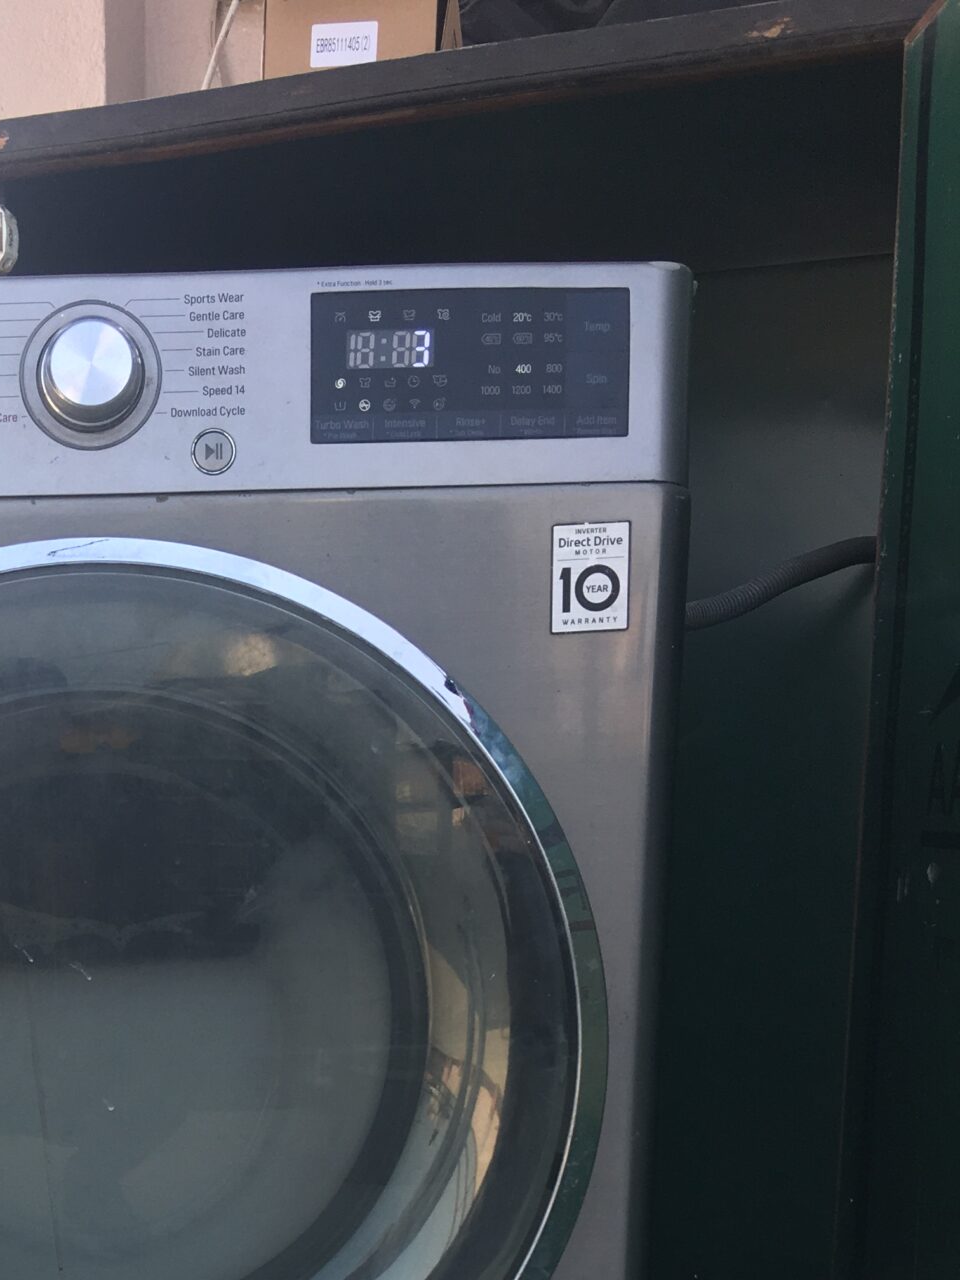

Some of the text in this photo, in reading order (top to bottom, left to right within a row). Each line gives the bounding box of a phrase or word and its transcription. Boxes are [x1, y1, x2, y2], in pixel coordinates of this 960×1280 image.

[184, 293, 244, 305] Sports Wear
[189, 310, 244, 321] Gentle Care
[481, 312, 502, 323] Cold
[208, 327, 246, 339] Delicate
[196, 346, 245, 357] Stain Care
[188, 364, 246, 376] Silent Wash
[488, 364, 501, 374] No
[515, 363, 532, 374] 400
[546, 363, 563, 373] 800
[203, 385, 245, 397] Speed 14
[480, 386, 500, 395] 1000
[512, 385, 531, 395] 1200
[543, 384, 562, 394] 1400
[171, 405, 245, 417] Download Cycle
[559, 536, 623, 548] Direct Drive
[560, 564, 620, 613] 10
[586, 585, 608, 593] YEAR
[562, 617, 617, 625] WARRANTY
